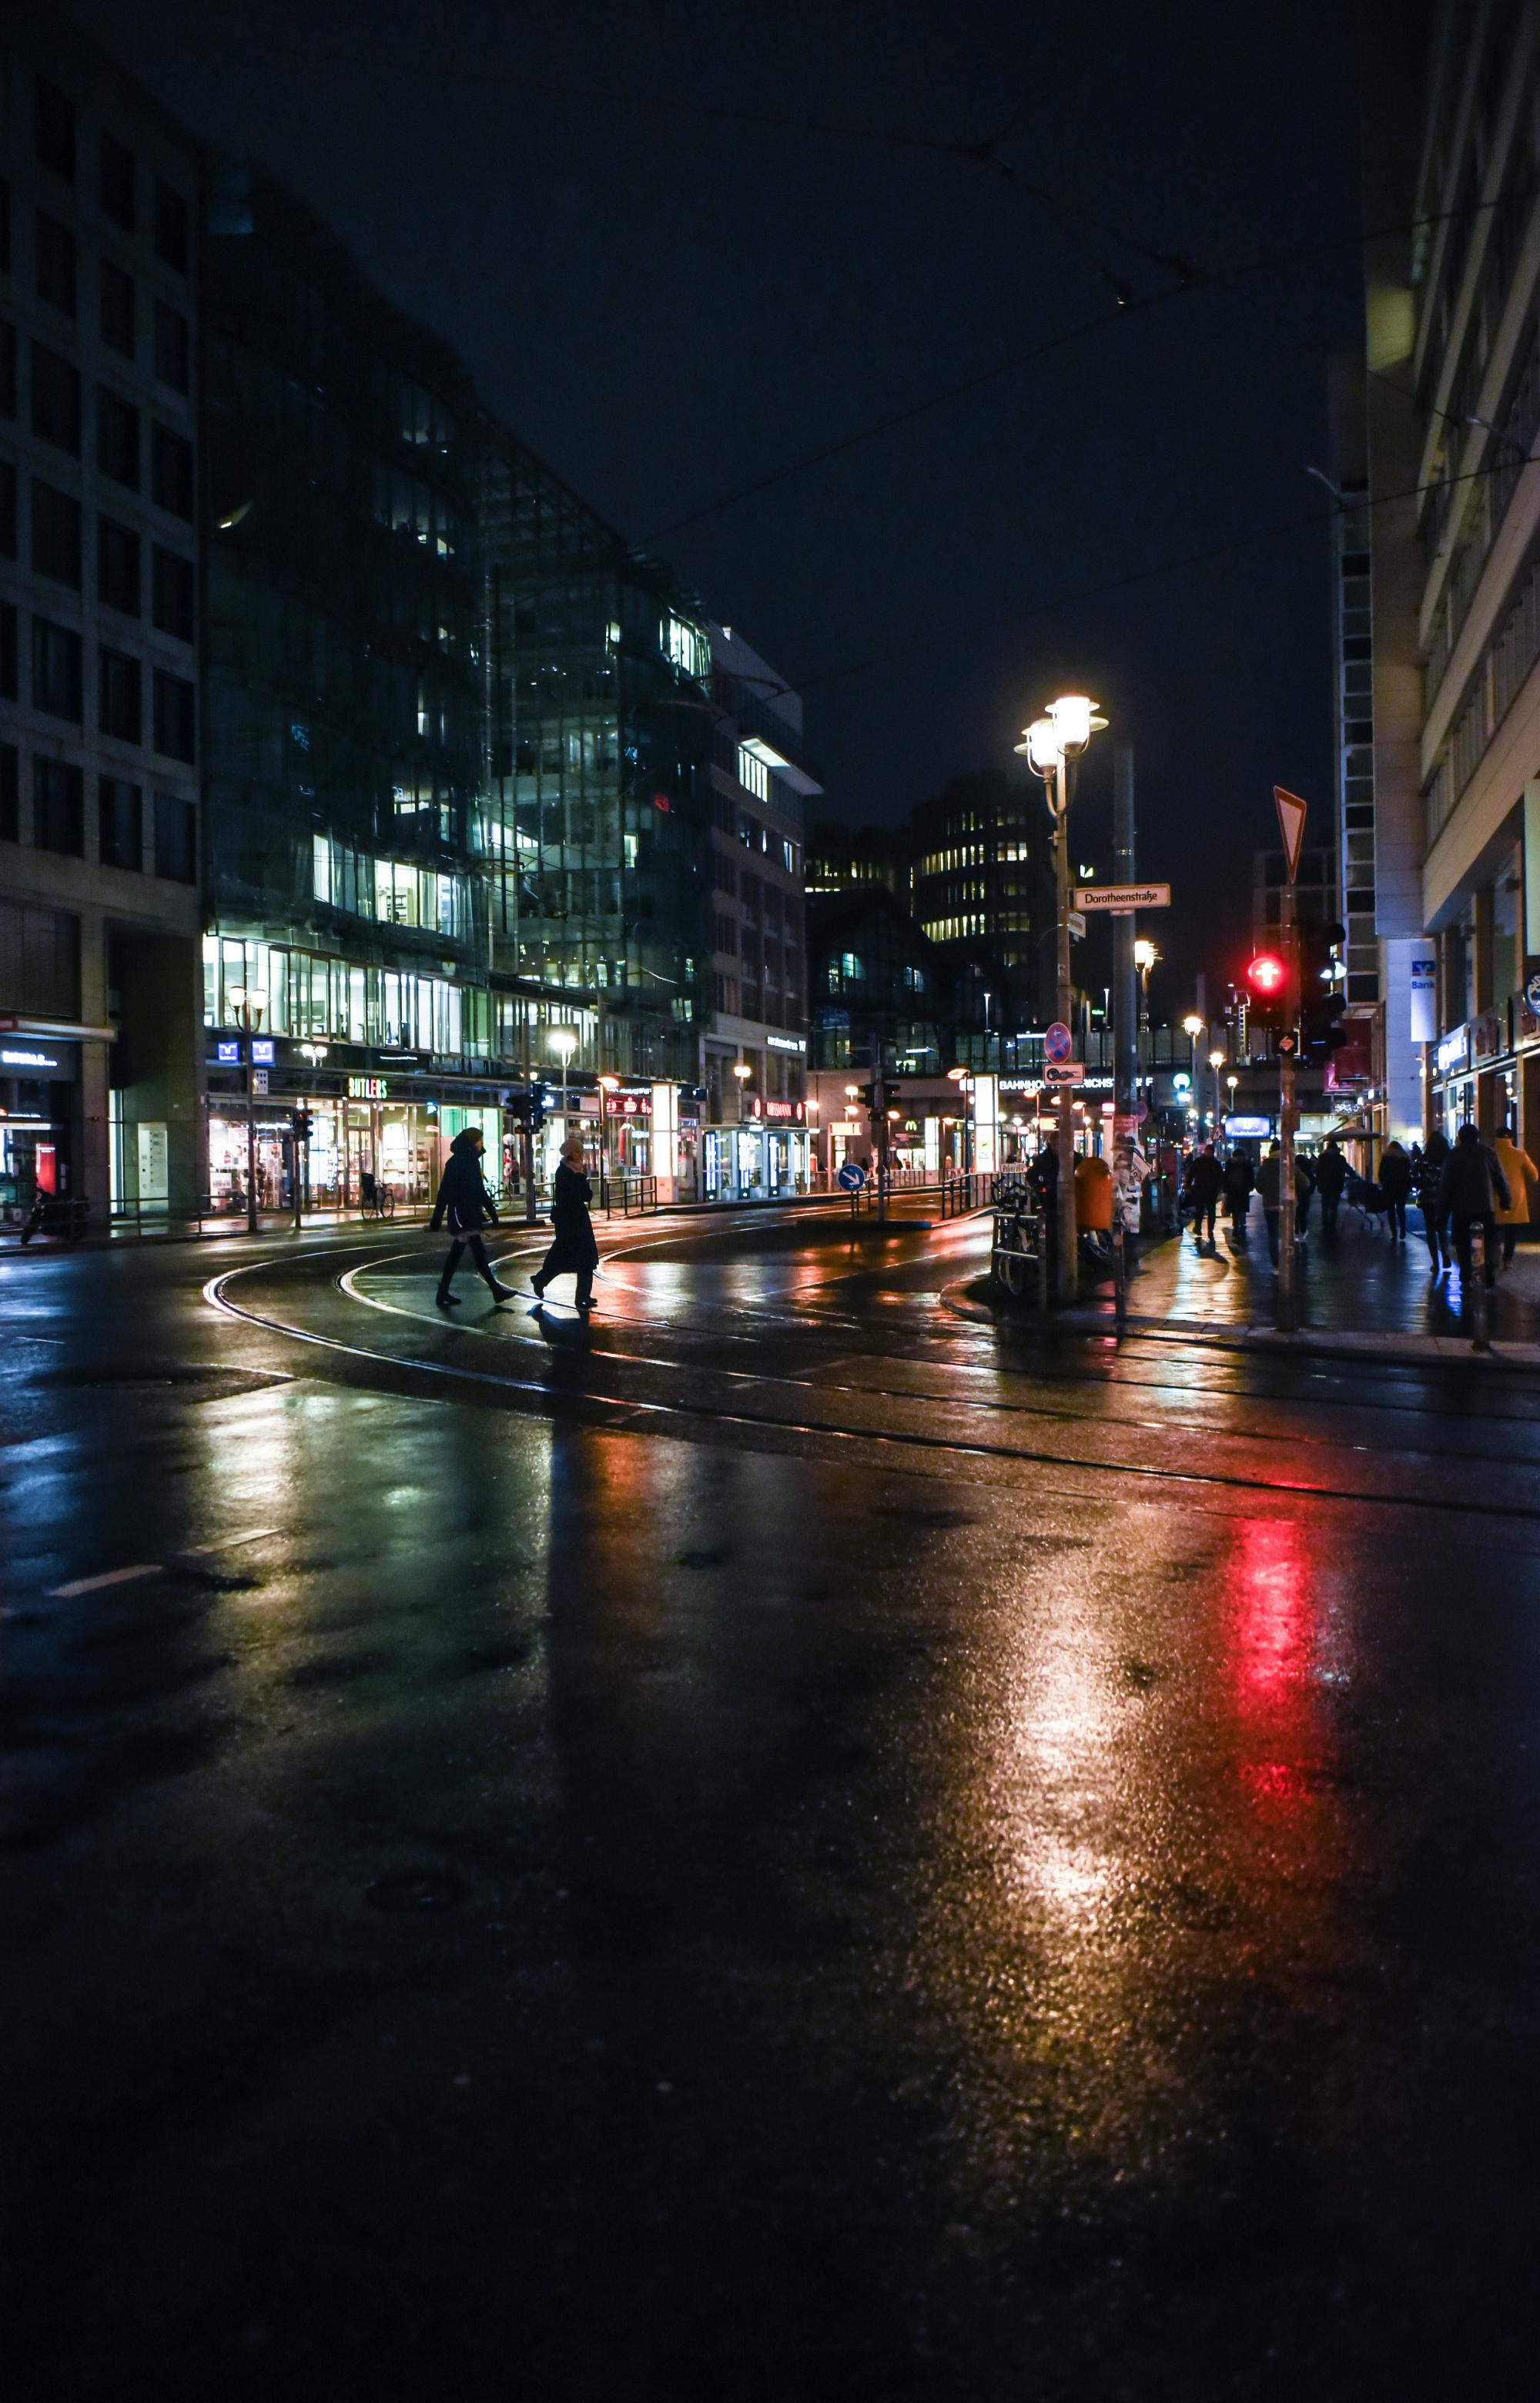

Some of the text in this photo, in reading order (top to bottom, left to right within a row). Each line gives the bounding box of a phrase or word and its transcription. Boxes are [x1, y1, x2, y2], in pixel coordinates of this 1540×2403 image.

[1085, 890, 1157, 903] Dorotheenstraße
[1411, 980, 1435, 990] Bank
[349, 1077, 387, 1099] BUTLERS
